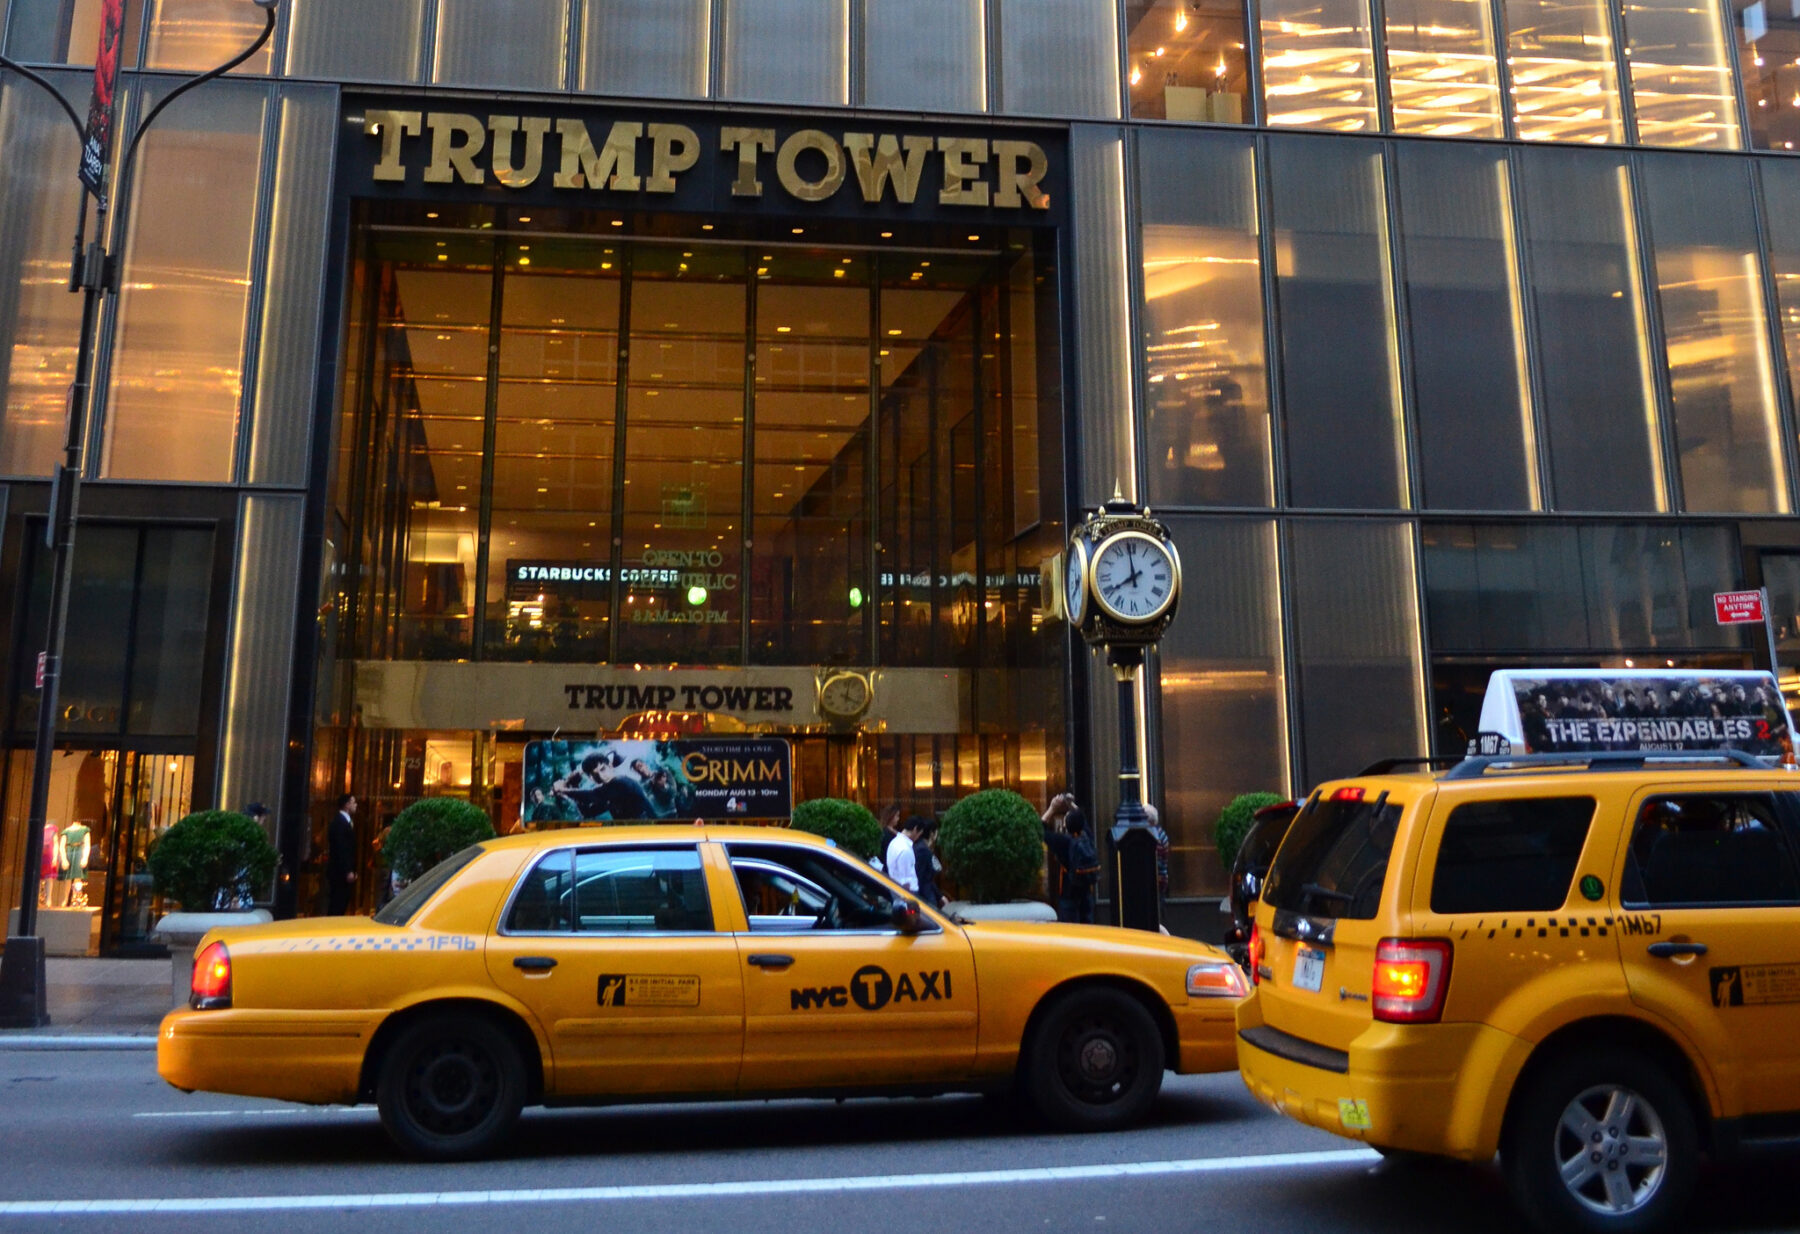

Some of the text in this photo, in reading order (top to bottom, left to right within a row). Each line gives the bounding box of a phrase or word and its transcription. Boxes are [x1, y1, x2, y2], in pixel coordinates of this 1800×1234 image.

[364, 108, 1050, 210] TRUMP TOWER
[642, 550, 723, 567] OPEN TO
[518, 566, 611, 581] STARBUCKS
[1717, 593, 1758, 604] NO STANDING
[1724, 602, 1755, 611] ANYTIME
[564, 684, 793, 711] TRUMP TOWER
[1546, 719, 1771, 743] THE EXPENDABLES 2
[1639, 742, 1672, 750] AUGUST
[681, 752, 782, 786] GRIMM
[695, 788, 728, 797] MONDAY
[729, 788, 746, 796] AUG
[747, 788, 756, 796] 13
[790, 965, 952, 1010] NYC TAXI
